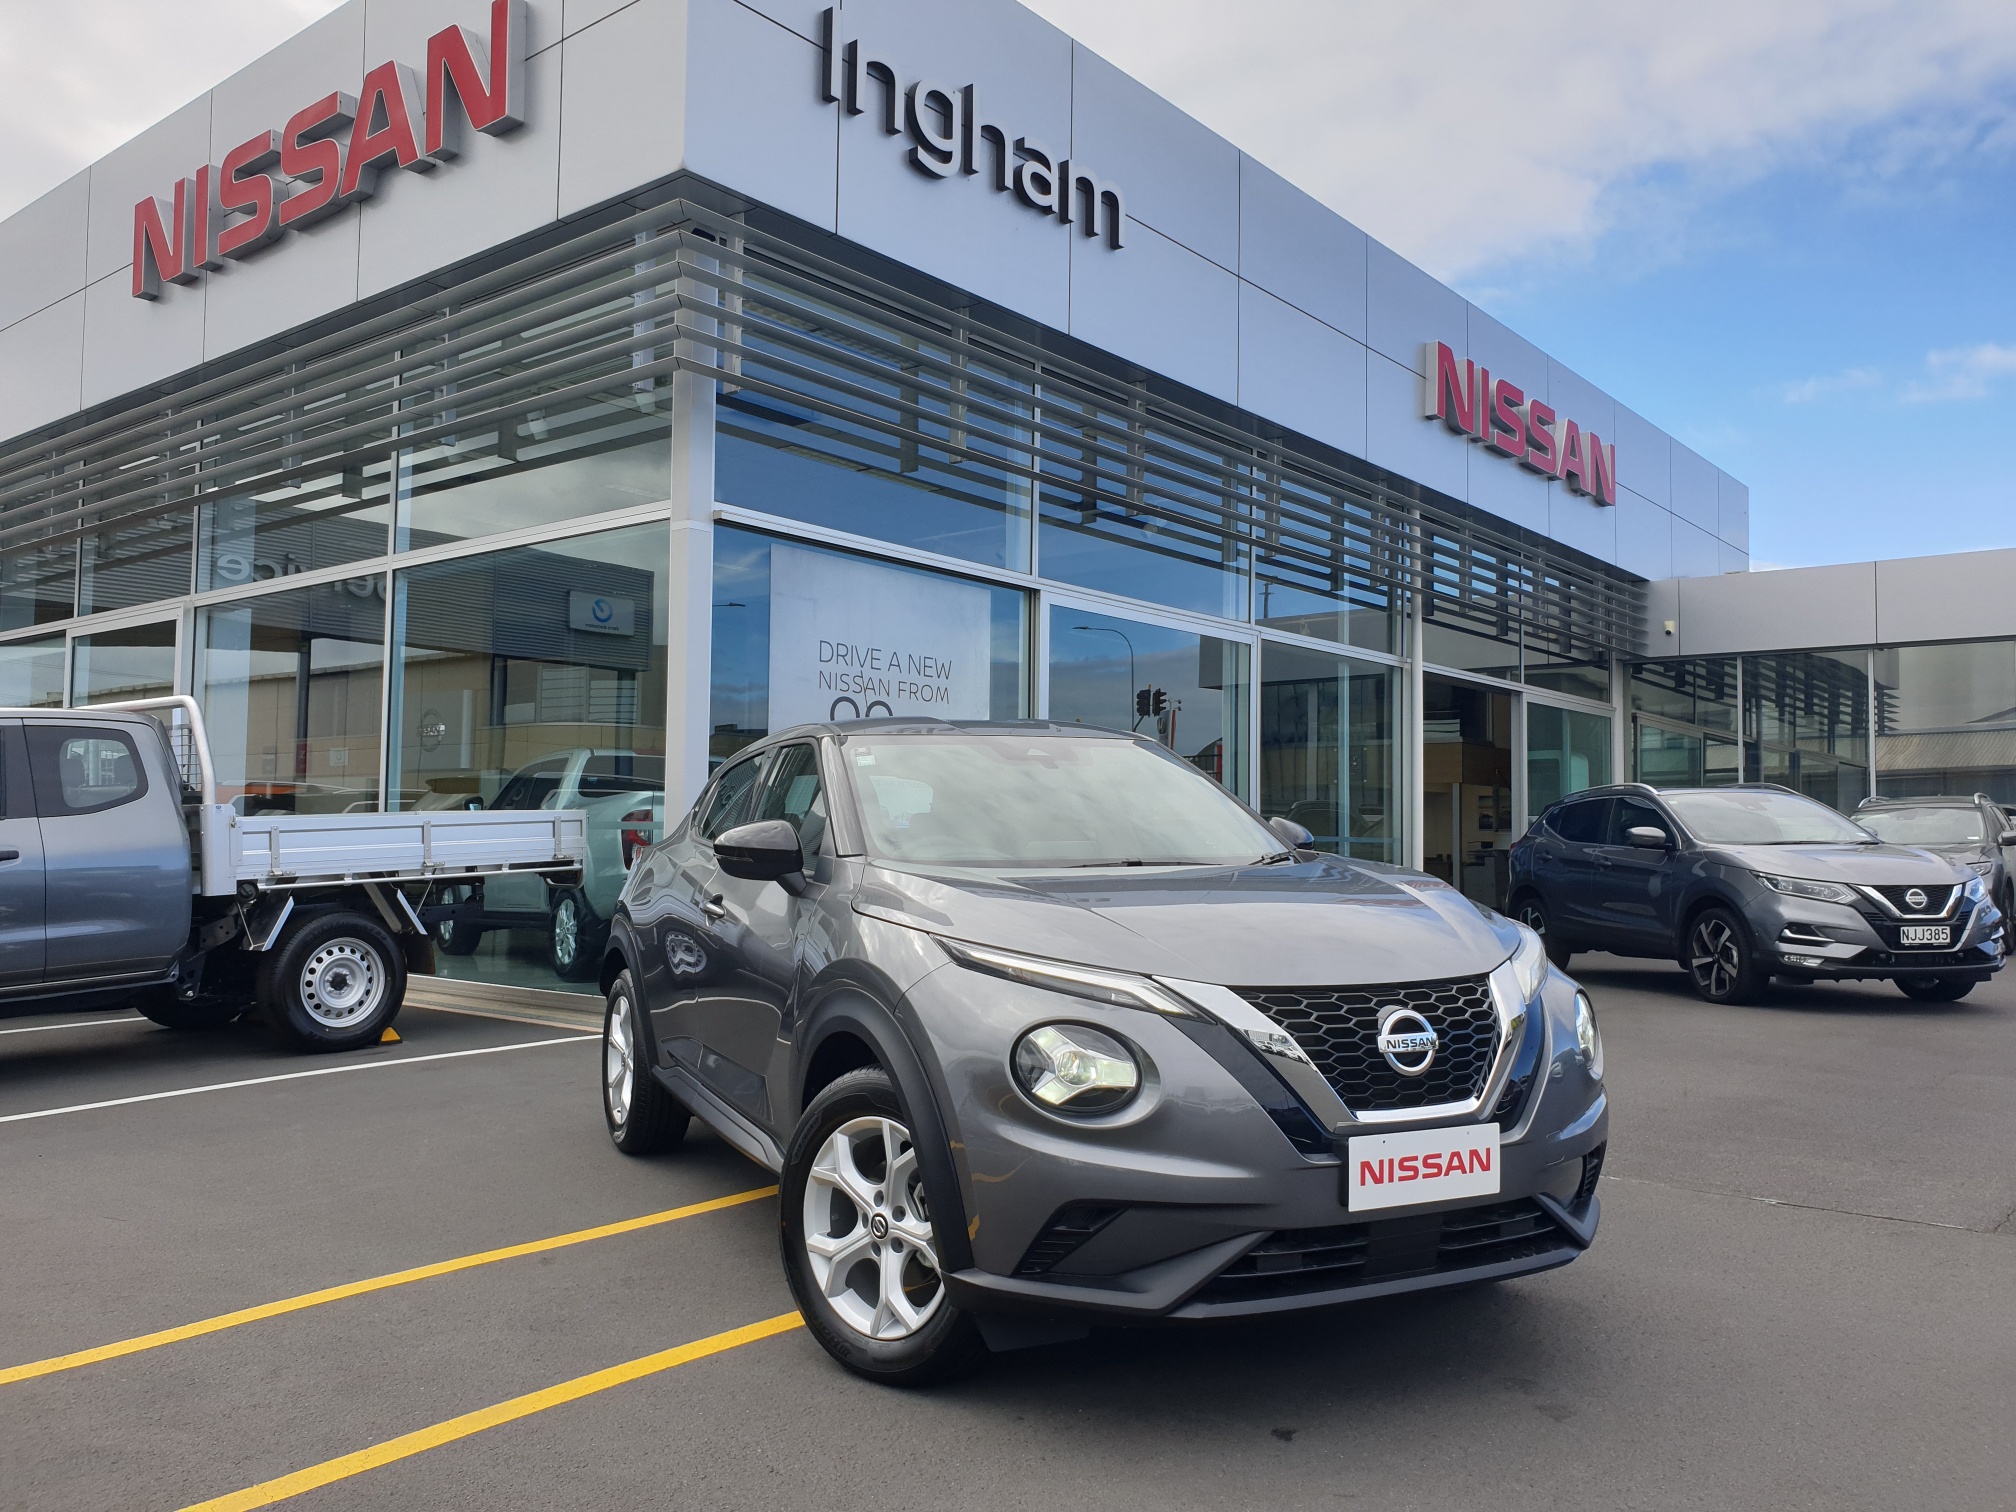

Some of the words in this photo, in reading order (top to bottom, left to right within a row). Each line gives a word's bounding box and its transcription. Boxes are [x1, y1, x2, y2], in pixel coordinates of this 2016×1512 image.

[822, 6, 1126, 249] Ingham
[132, 0, 522, 299] NISSAN
[1426, 340, 1615, 506] NISSAN
[819, 640, 882, 671] DRIVE
[887, 651, 902, 674] A
[908, 654, 952, 680] NEW
[819, 670, 890, 698] NISSAN
[898, 681, 950, 704] FROM
[1902, 928, 1949, 941] NJJ385
[1386, 1037, 1434, 1049] NISSAN
[1360, 1147, 1491, 1186] NISSAN
